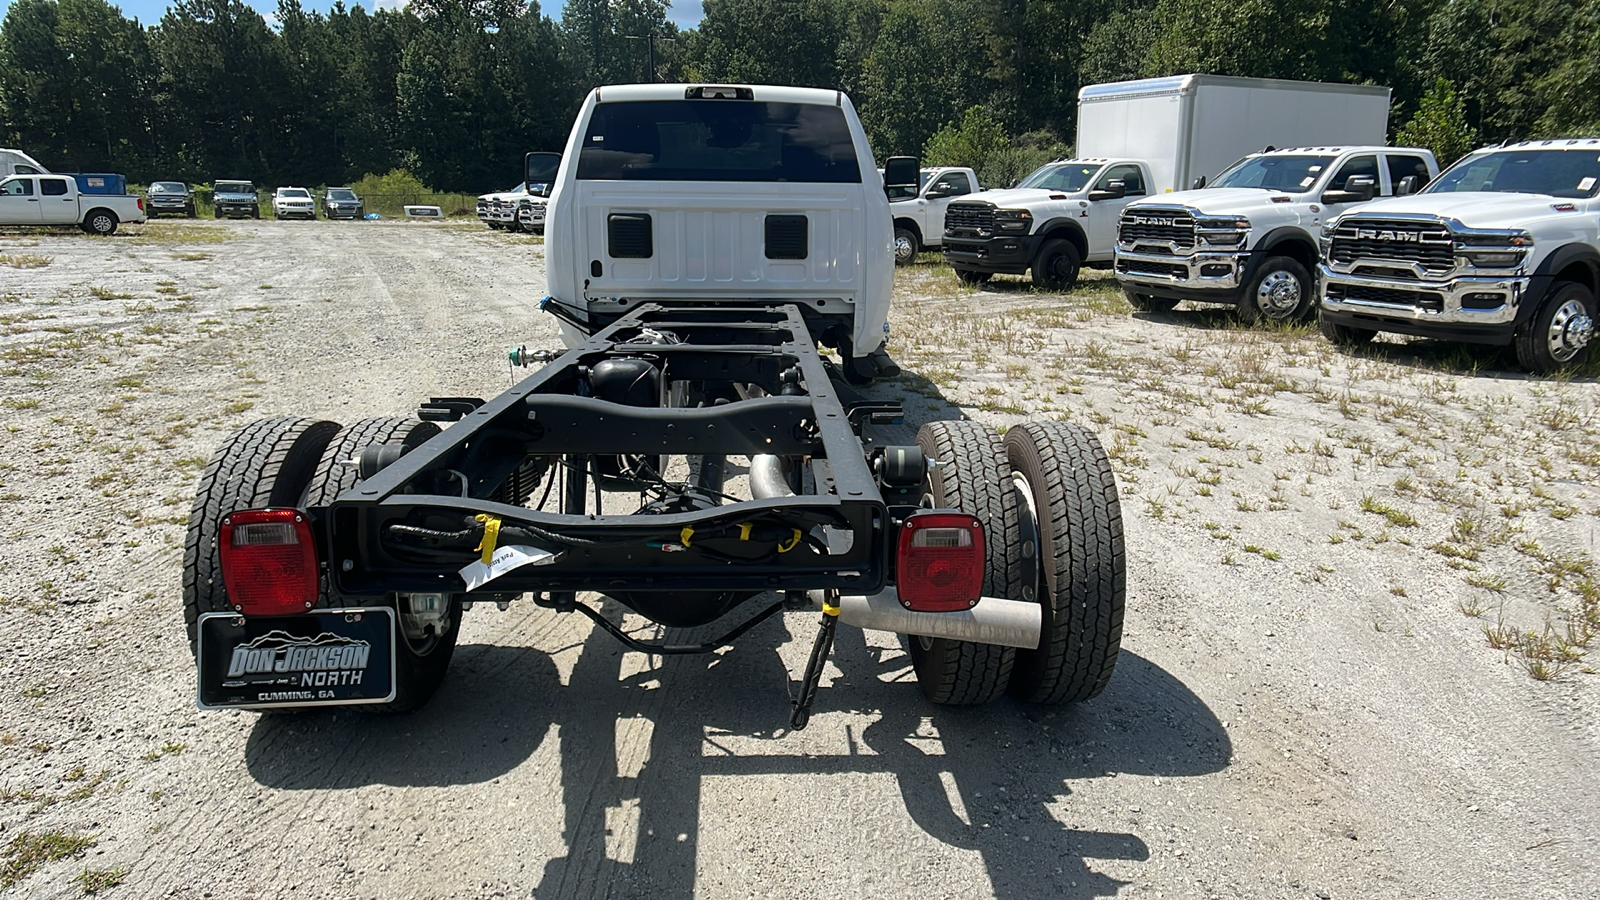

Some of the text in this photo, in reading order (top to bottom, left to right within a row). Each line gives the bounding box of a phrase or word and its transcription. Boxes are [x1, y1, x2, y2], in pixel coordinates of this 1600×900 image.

[1136, 216, 1173, 226] RAM
[1359, 229, 1419, 242] RAM
[501, 552, 514, 561] Park
[227, 645, 371, 677] DON JACKSON
[301, 670, 363, 687] NORTH
[258, 690, 335, 701] CUMMING, GA
